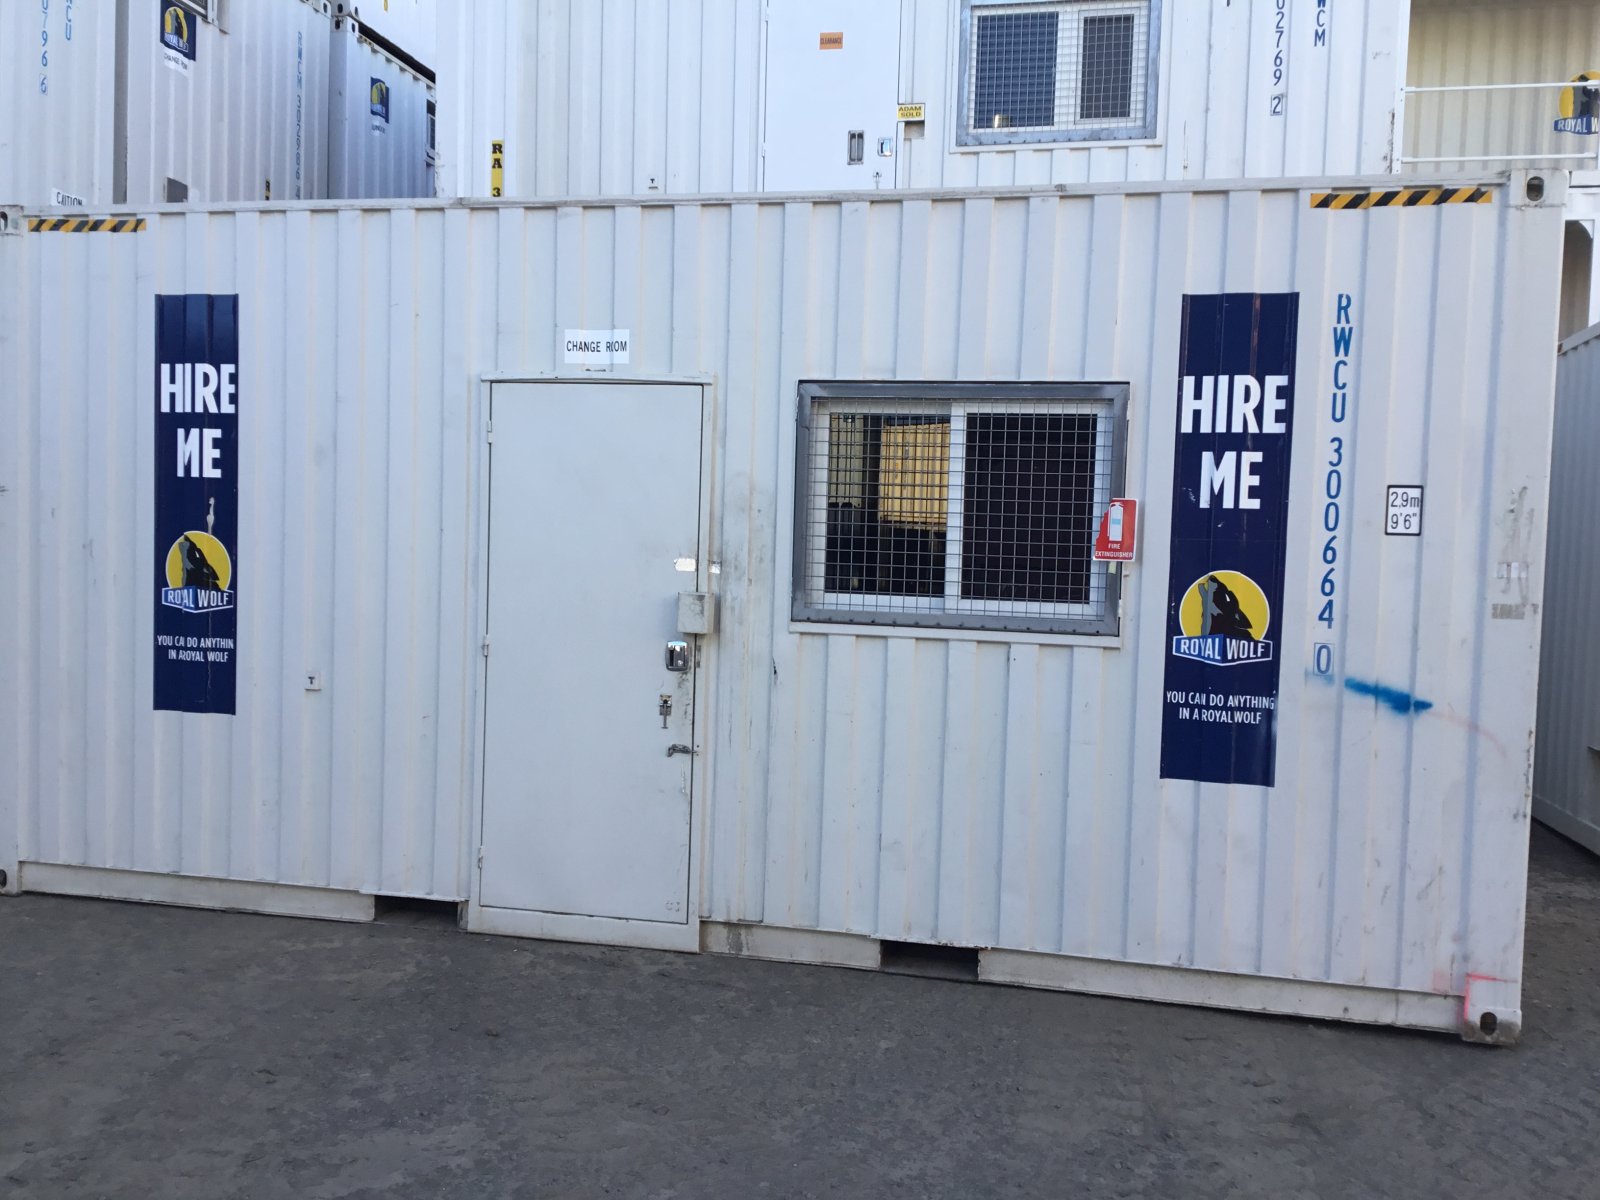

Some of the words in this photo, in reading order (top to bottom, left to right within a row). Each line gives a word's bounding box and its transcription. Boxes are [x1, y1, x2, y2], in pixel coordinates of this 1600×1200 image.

[65, 0, 73, 41] CU
[1272, 96, 1282, 115] 2
[1558, 119, 1587, 133] ROYAL
[492, 187, 501, 197] 3
[566, 340, 601, 353] CHANGE
[1331, 293, 1353, 423] RWCU
[160, 363, 236, 414] HIRE
[1180, 374, 1289, 434] HIRE
[176, 427, 222, 478] ME
[1199, 451, 1263, 510] ME
[1317, 436, 1344, 630] 300664
[168, 589, 195, 608] ROYAL
[197, 588, 229, 608] WOLF
[156, 634, 173, 646] YOU
[187, 637, 198, 648] DO
[1180, 637, 1222, 660] ROYAL
[1226, 638, 1266, 660] WOLF
[168, 649, 177, 660] IN
[206, 650, 229, 663] WOLF
[1166, 690, 1186, 704] YOU
[1188, 692, 1206, 706] CAN
[1209, 694, 1224, 707] DO
[1227, 695, 1275, 710] ANYTHING
[1179, 707, 1190, 720] IN
[1193, 708, 1199, 721] A
[1201, 709, 1233, 724] ROYAL
[1234, 711, 1262, 725] WOLF
